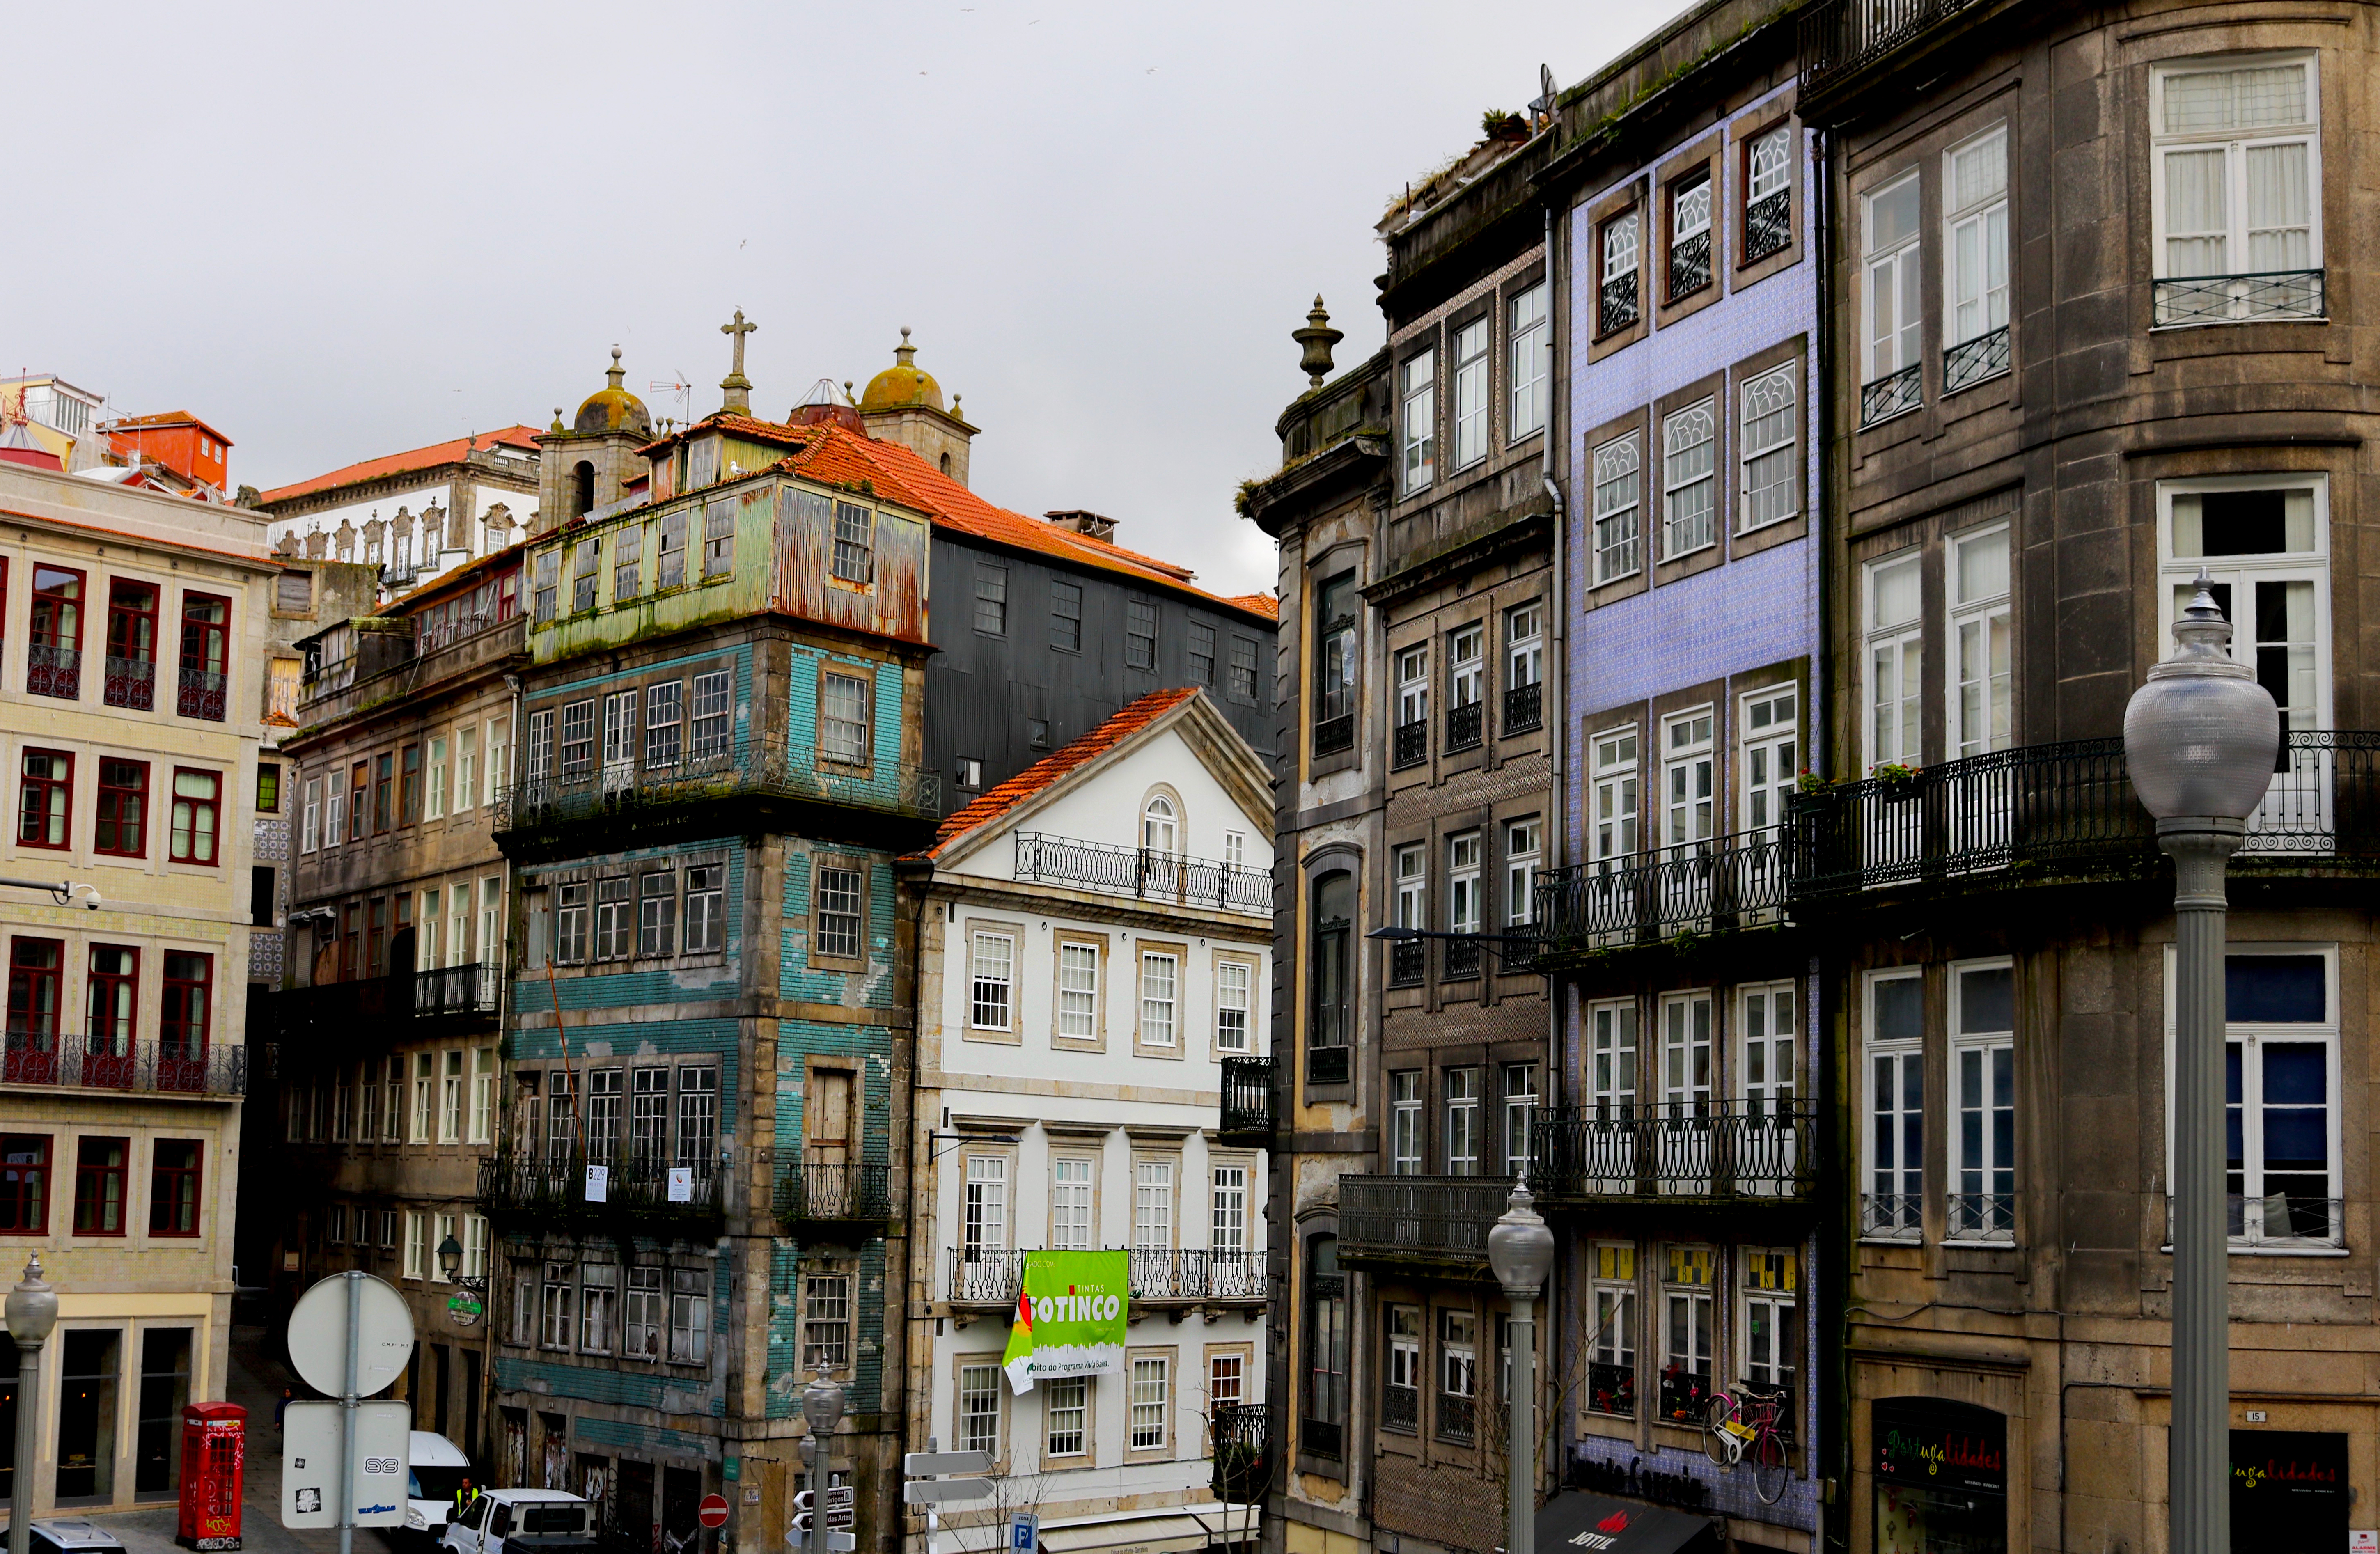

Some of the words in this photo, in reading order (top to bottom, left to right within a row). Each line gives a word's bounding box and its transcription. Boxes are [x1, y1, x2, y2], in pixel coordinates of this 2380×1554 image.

[589, 1168, 605, 1180] B229
[1077, 1284, 1104, 1293] TINTAS
[1030, 1285, 1120, 1323] SOTINCO
[1049, 1362, 1057, 1371] do
[1058, 1362, 1083, 1372] Programa
[2252, 1412, 2259, 1420] 15
[1888, 1429, 2001, 1475] Portugalidades
[2229, 1458, 2336, 1488] tugalidades
[828, 1496, 844, 1504] érigos
[1018, 1527, 1029, 1546] P
